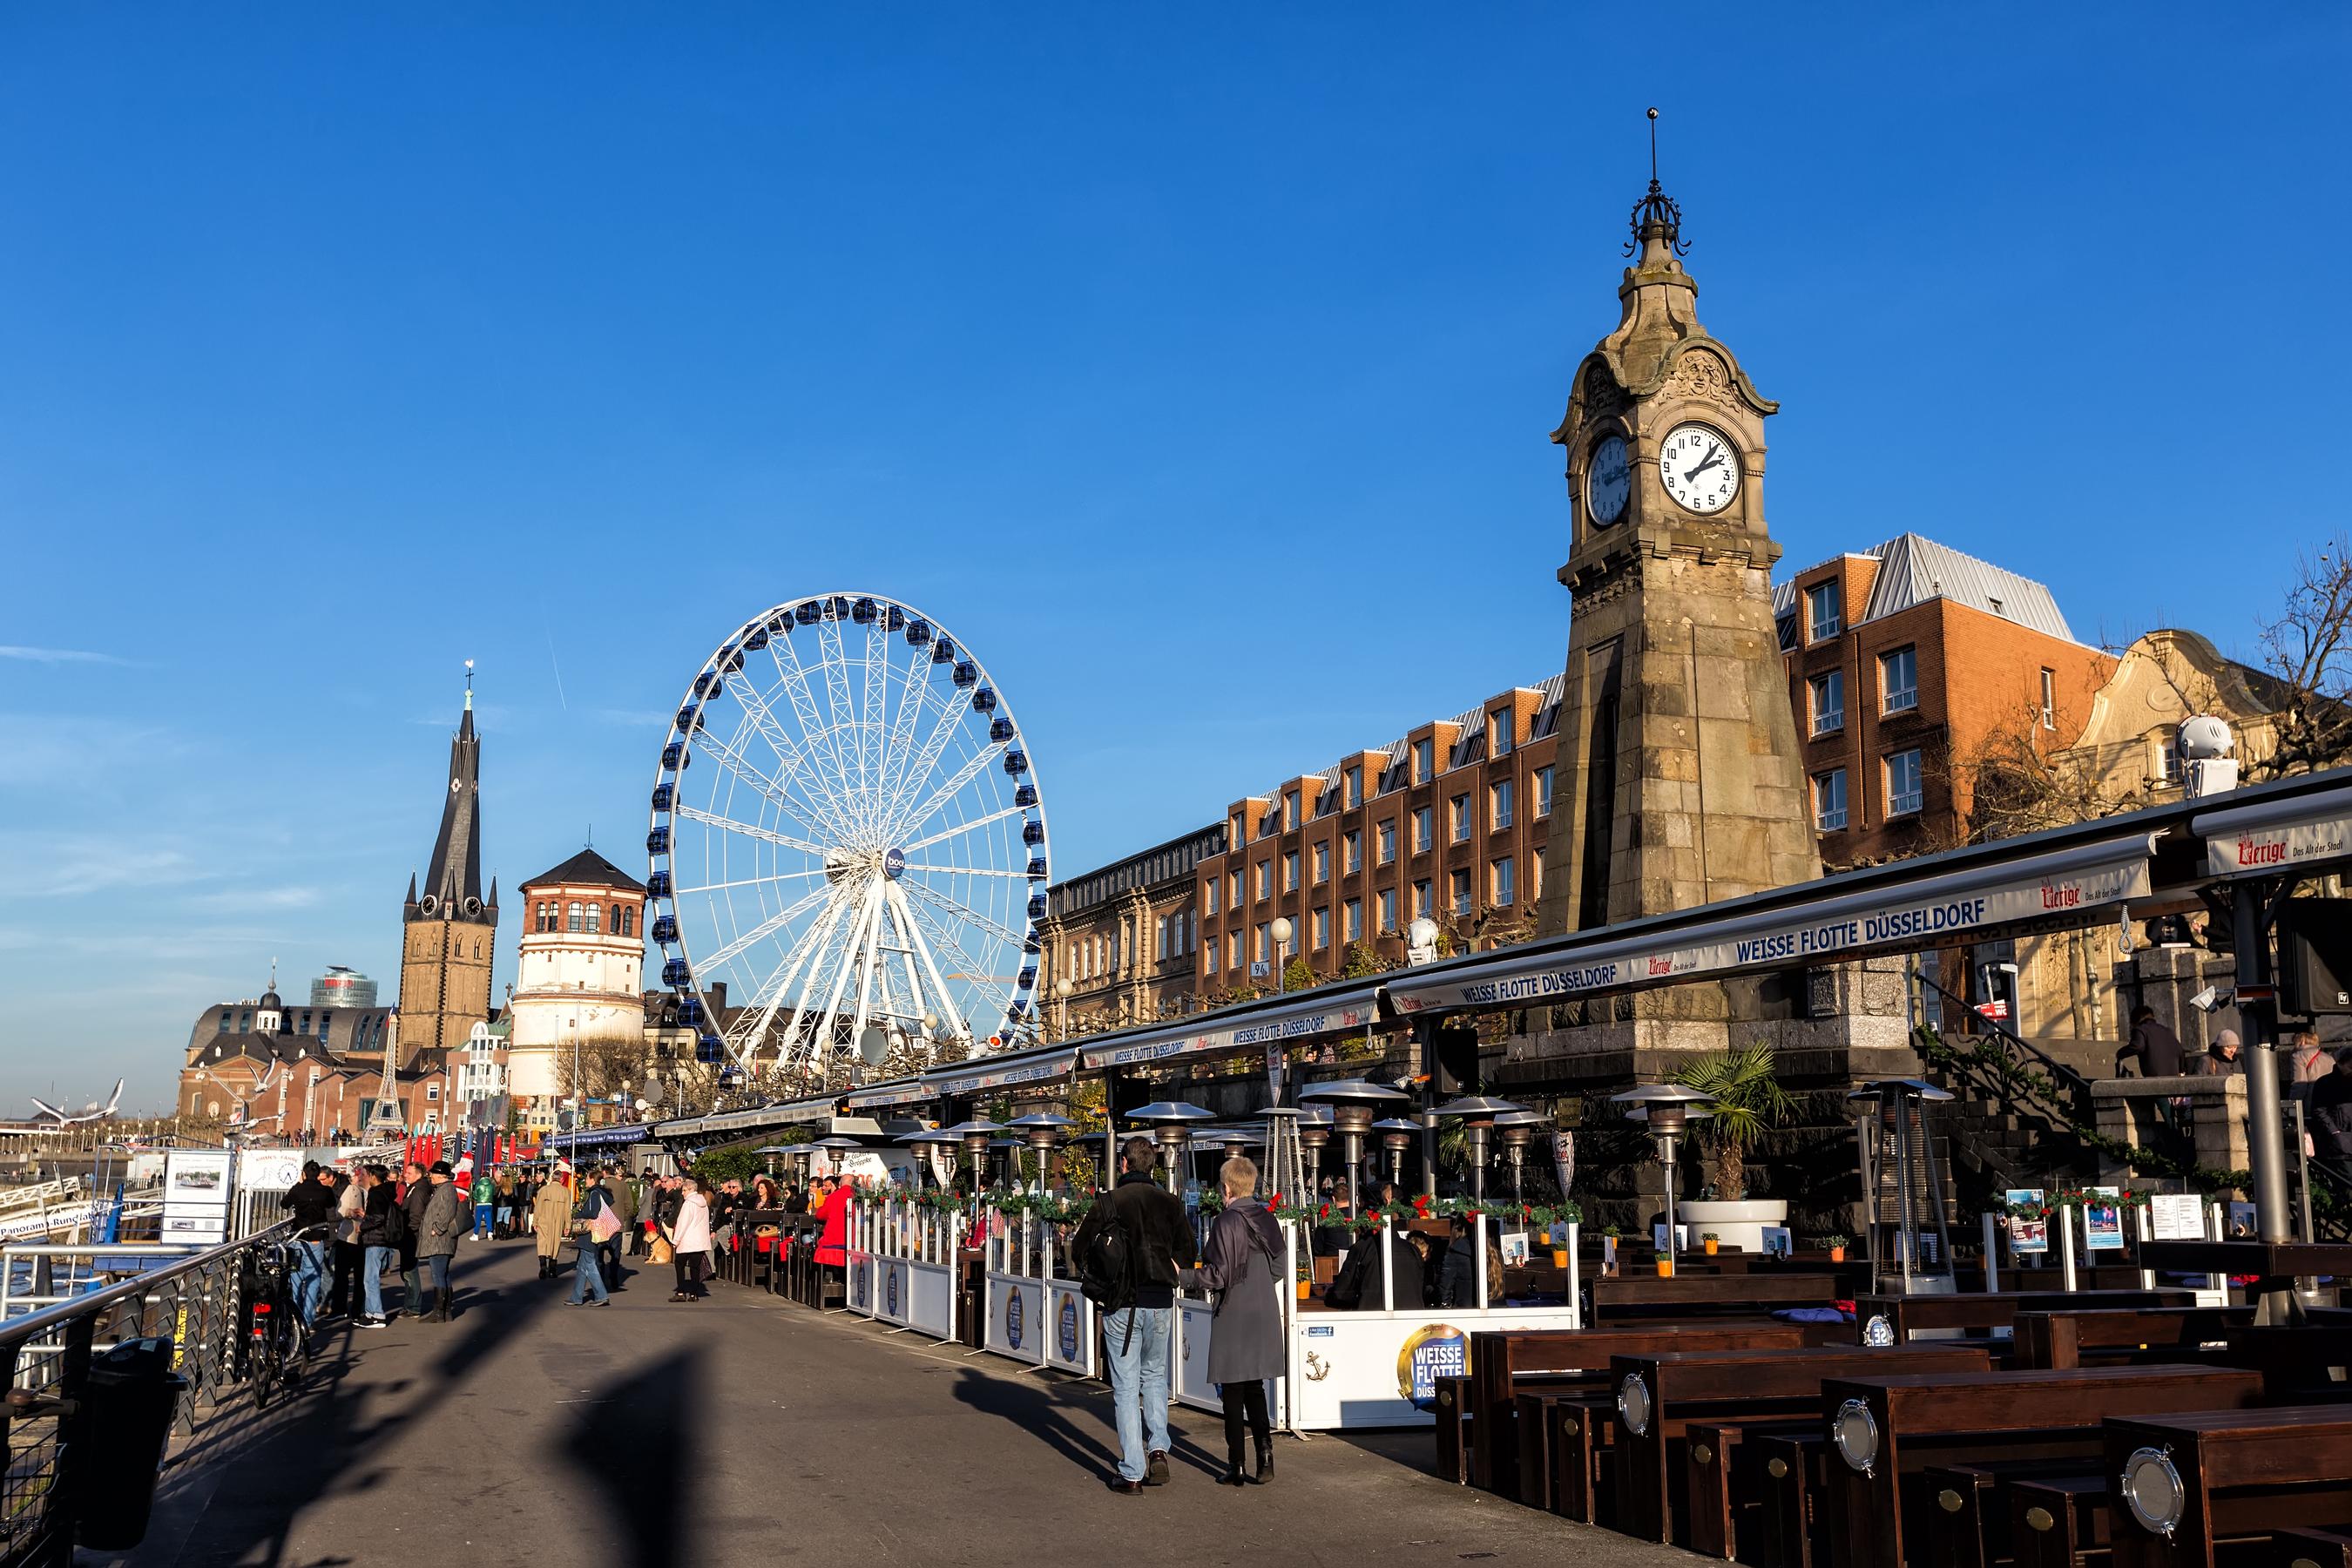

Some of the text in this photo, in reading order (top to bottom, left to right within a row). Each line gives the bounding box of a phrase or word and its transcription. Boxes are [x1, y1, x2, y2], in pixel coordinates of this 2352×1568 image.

[1679, 438, 1685, 449] 11
[1691, 435, 1700, 446] 12
[1667, 448, 1676, 460] 10
[1718, 455, 1725, 466] 2
[1663, 462, 1670, 473] 9
[1723, 470, 1730, 480] 3
[1668, 476, 1675, 488] 8
[1720, 484, 1727, 494] 4
[1679, 490, 1685, 501] 7
[1709, 494, 1715, 505] 5
[1694, 498, 1700, 509] 6
[2238, 836, 2343, 865] Uerige Das Alt der Stadt
[2041, 882, 2080, 909] Uerige
[1737, 934, 1794, 963] WEISSE
[1801, 922, 1858, 952] FLOTTE
[1865, 899, 1985, 941] DÜSSELDORF
[1460, 964, 1616, 1004] WEISSE FLOTTE DÜSSELDORF
[1233, 1016, 1325, 1044] WEISSE FLOTTE DÜSSELDORF
[1115, 1050, 1132, 1062] WEISSE
[1134, 1046, 1152, 1060] FLOTTE
[1415, 1347, 1461, 1364] WEISSE
[1416, 1365, 1462, 1384] FLOTTE
